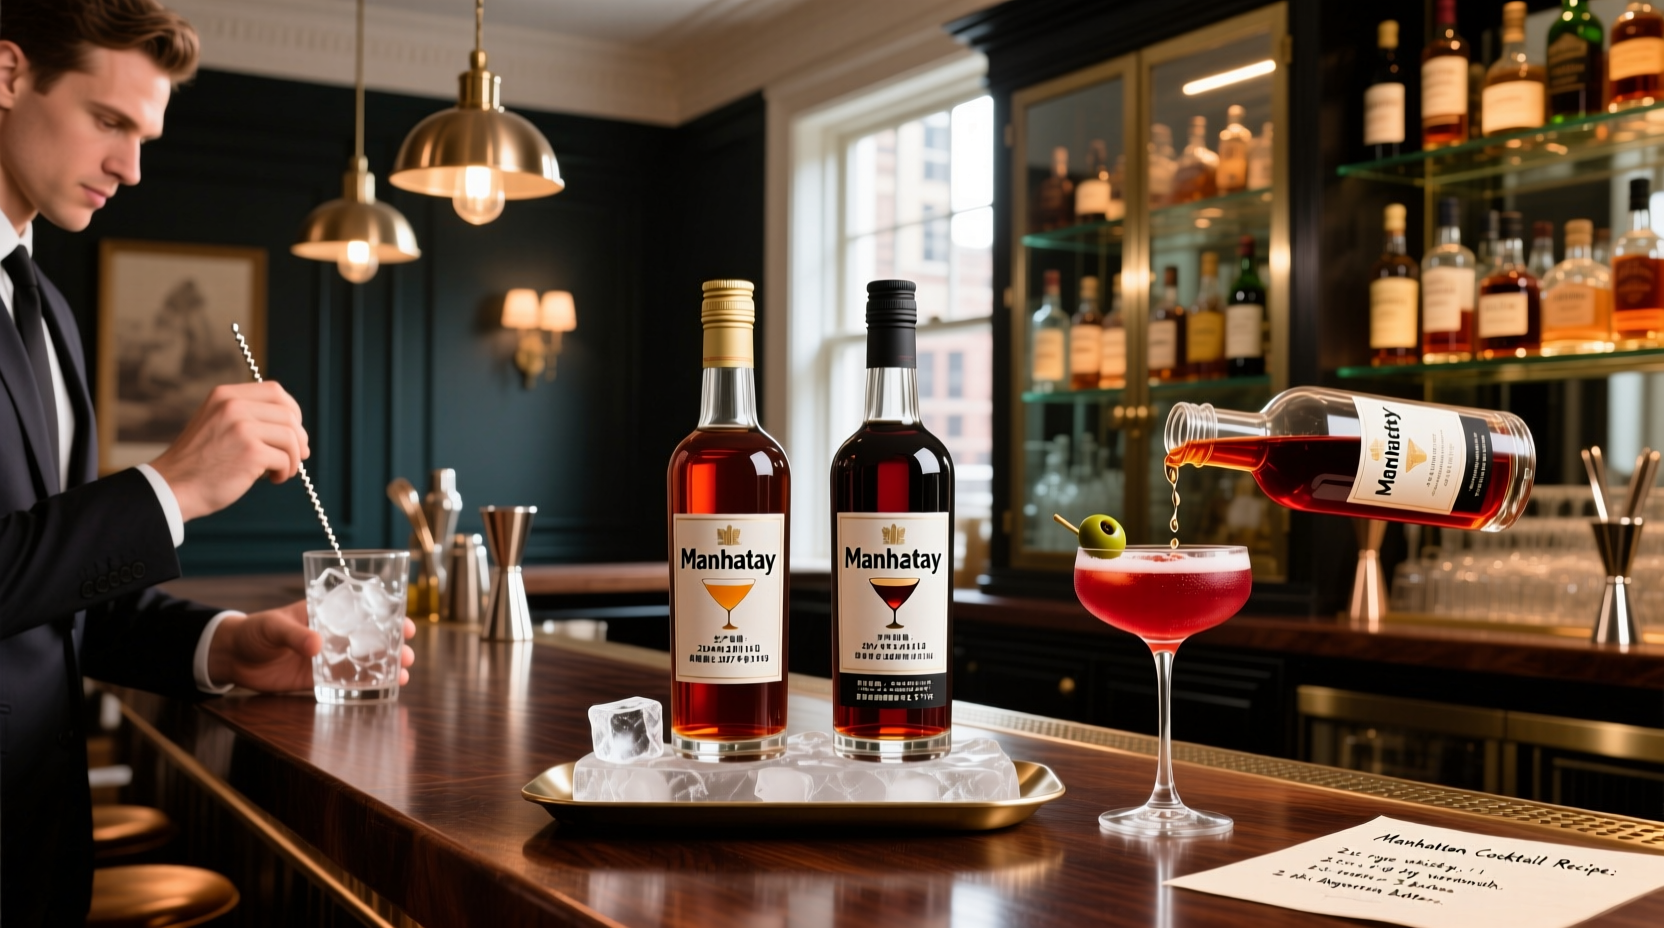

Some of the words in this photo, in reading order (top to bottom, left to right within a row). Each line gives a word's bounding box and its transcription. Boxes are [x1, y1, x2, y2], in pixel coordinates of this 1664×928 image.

[681, 548, 776, 575] Manhatay
[845, 547, 942, 575] Manhatay
[1552, 858, 1617, 876] Recipe:
